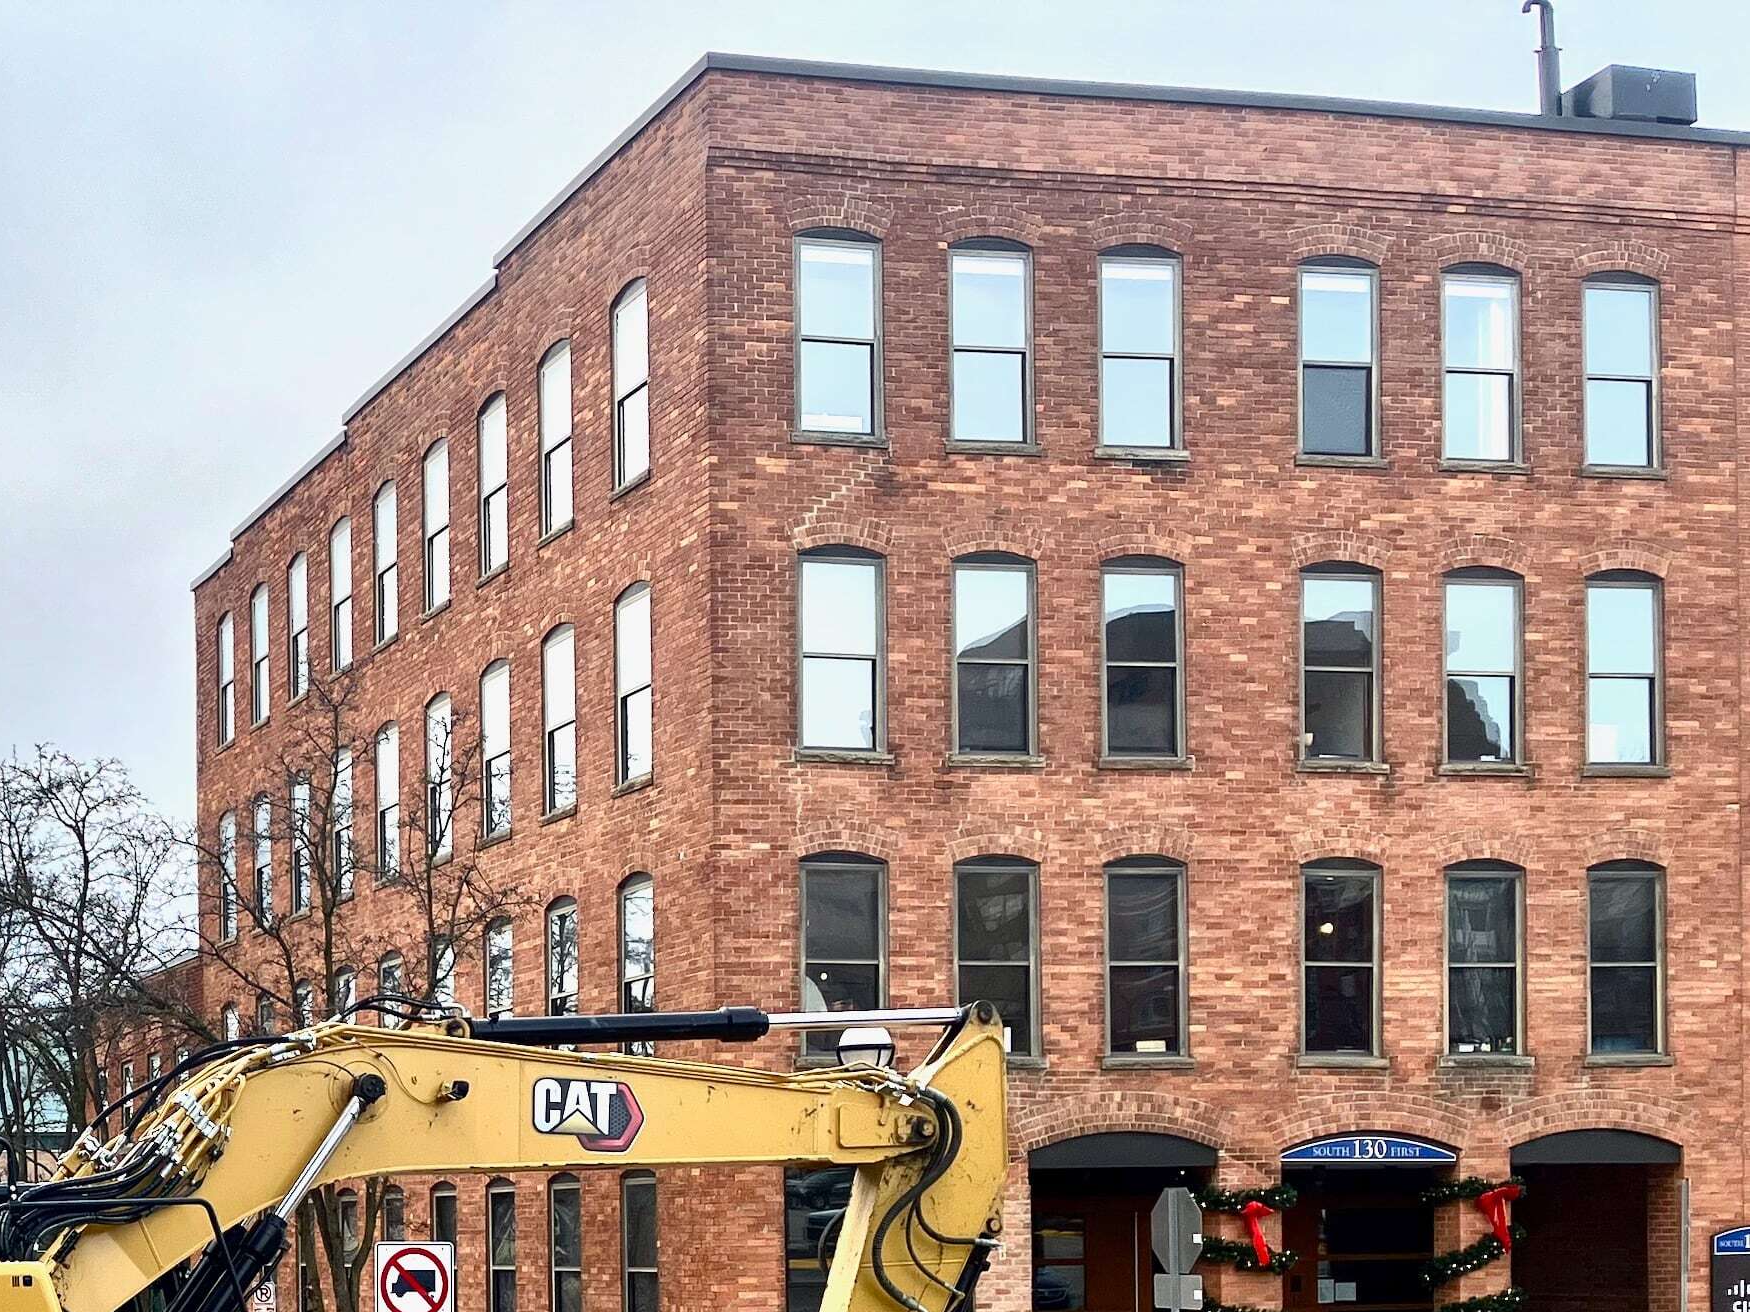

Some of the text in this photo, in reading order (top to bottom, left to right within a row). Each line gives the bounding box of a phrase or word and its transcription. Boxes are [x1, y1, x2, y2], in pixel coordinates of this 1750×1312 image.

[534, 1078, 619, 1136] CAT
[1312, 1139, 1421, 1159] SOUTH 130 FIRST
